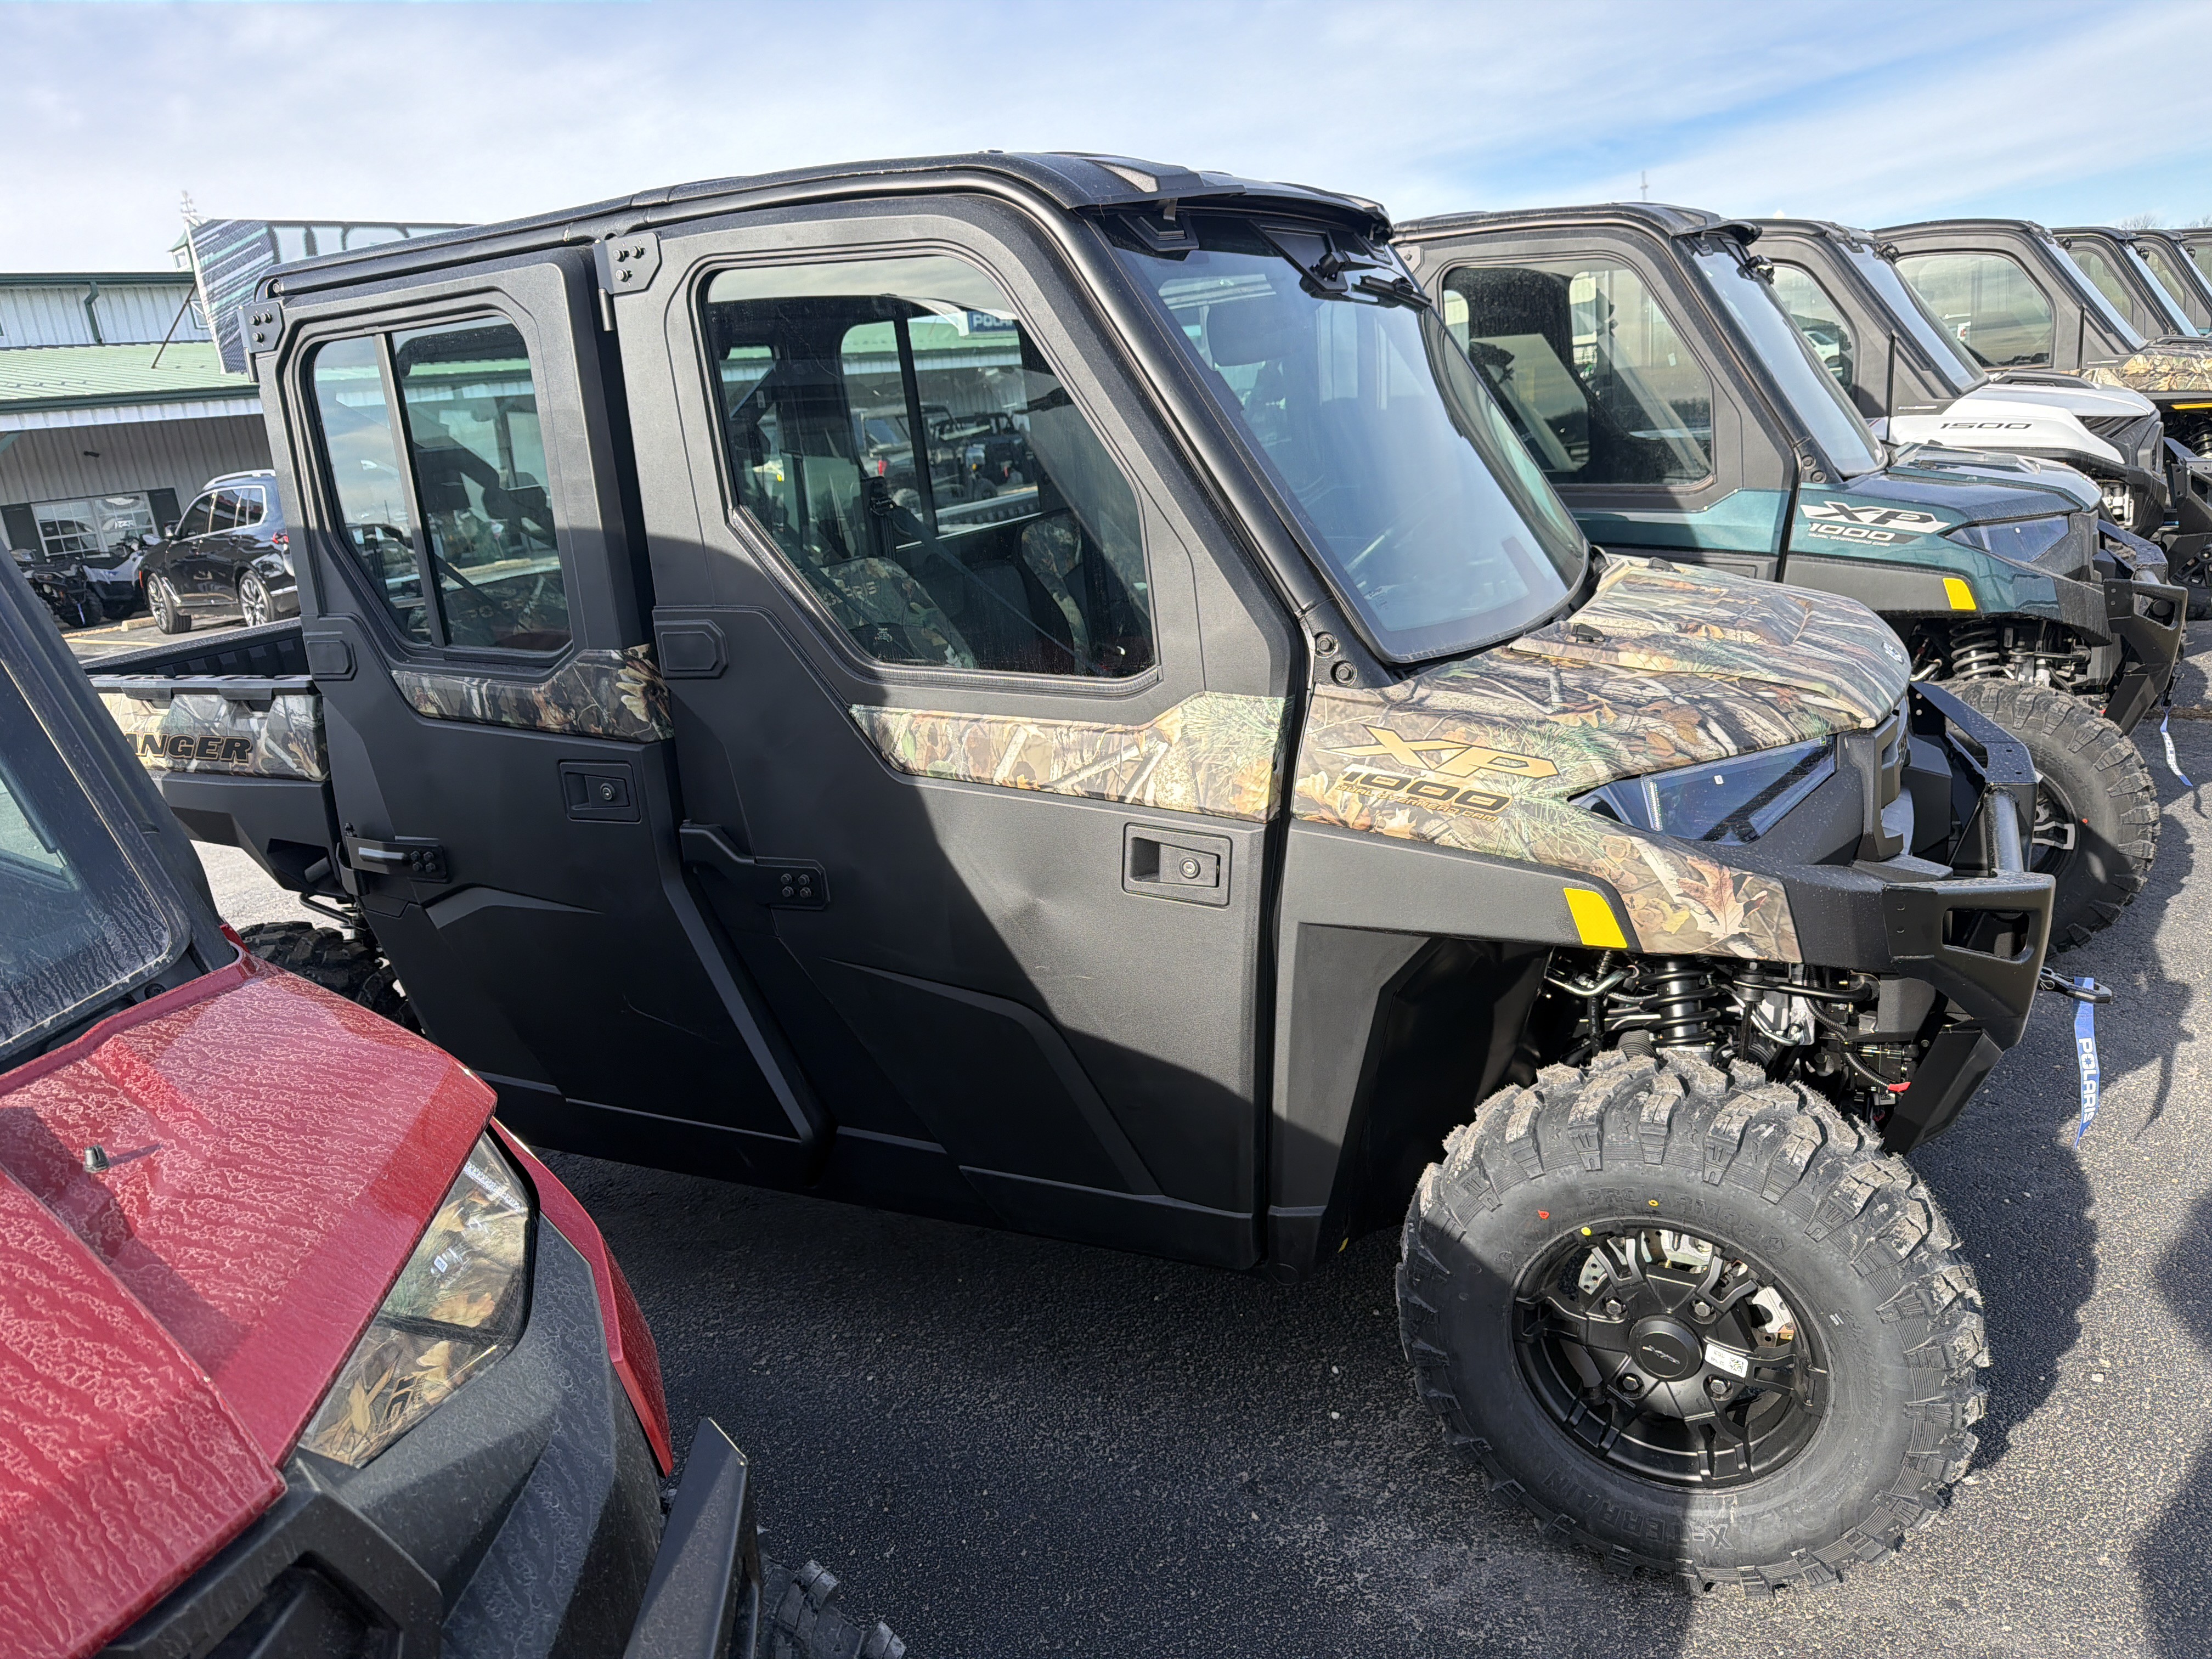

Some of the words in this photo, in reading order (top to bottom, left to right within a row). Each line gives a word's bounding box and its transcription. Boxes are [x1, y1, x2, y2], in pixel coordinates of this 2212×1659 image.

[1807, 501, 1936, 526] XP
[1809, 522, 1895, 541] 1000
[1315, 723, 1560, 778] XP
[1336, 785, 1375, 797] DUAL
[1377, 792, 1460, 815] OVERHEAD
[1461, 811, 1500, 823] CAM
[1341, 771, 1513, 814] 1000
[2079, 1038, 2097, 1124] POLARIS
